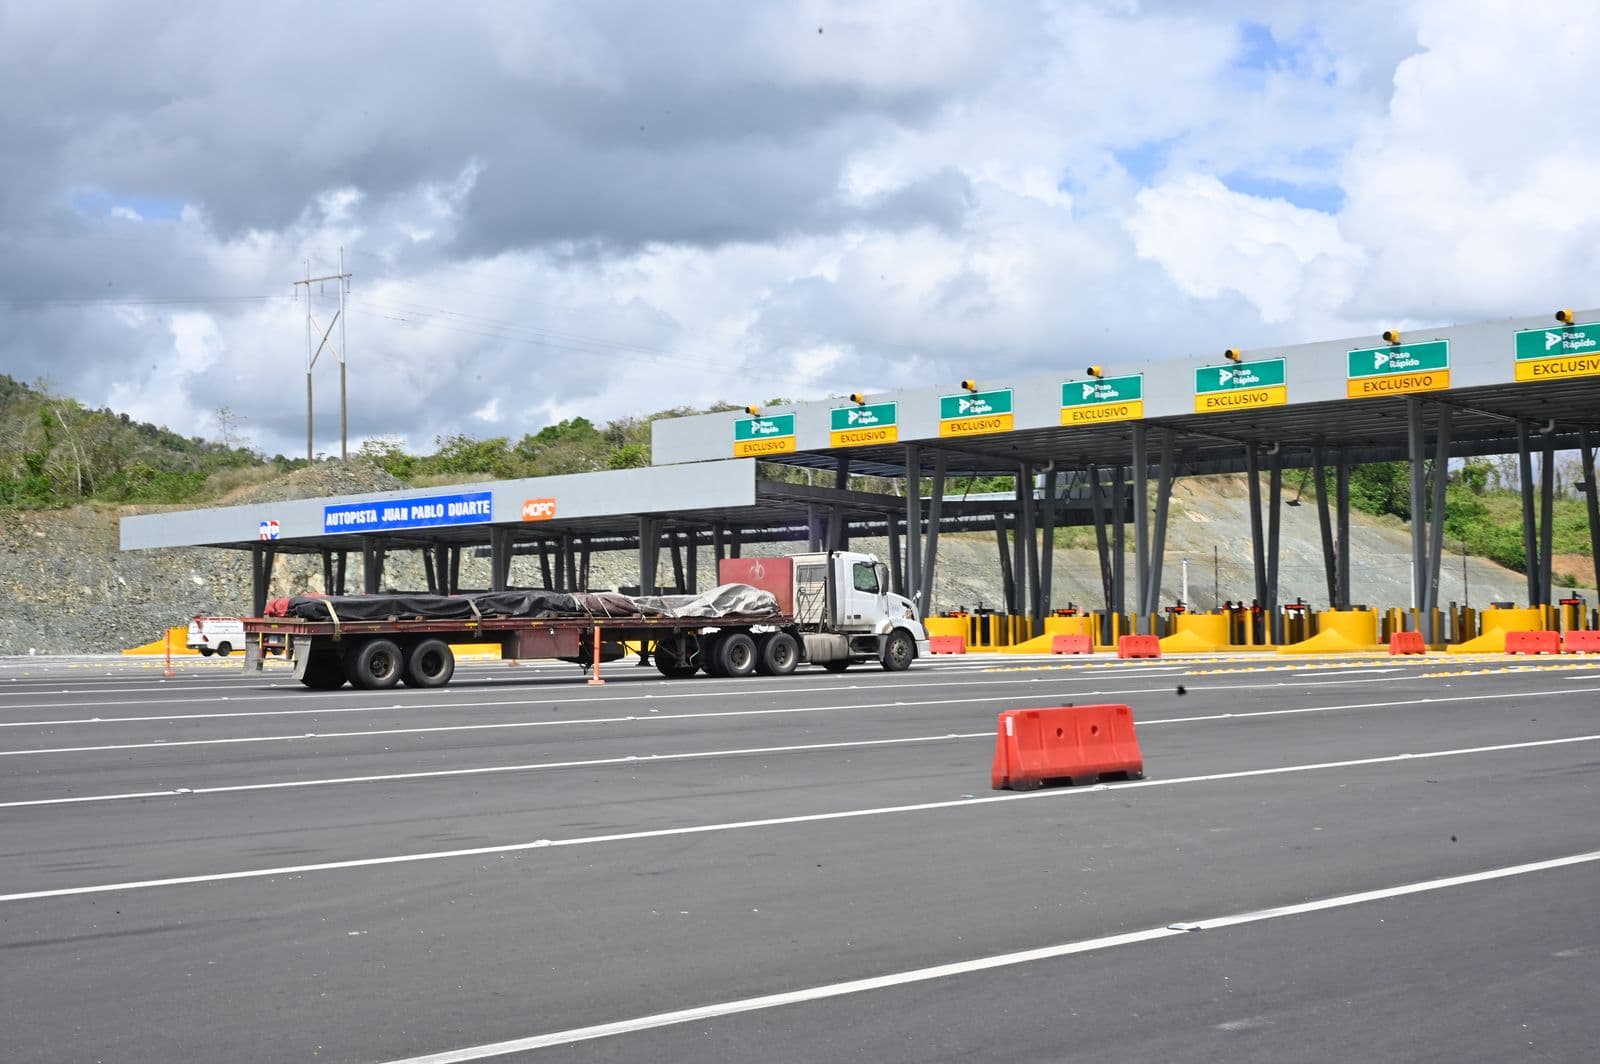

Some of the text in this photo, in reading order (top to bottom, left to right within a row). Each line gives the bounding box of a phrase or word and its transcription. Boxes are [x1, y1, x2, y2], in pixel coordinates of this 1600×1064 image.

[1562, 332, 1585, 340] Paso
[1389, 352, 1410, 360] Paso
[1533, 359, 1600, 375] EXCLUSIV
[1363, 376, 1433, 392] EXCLUSIVO
[1207, 392, 1269, 407] EXCLUSIVO
[1072, 406, 1129, 421] EXCLUSIVO
[951, 419, 1001, 432] EXCLUSIVO
[840, 430, 886, 443] EXCLUSIVO
[743, 441, 786, 453] EXCLUSIVO
[326, 500, 490, 526] AUTOPISTA JUAN PABLO DUARTE
